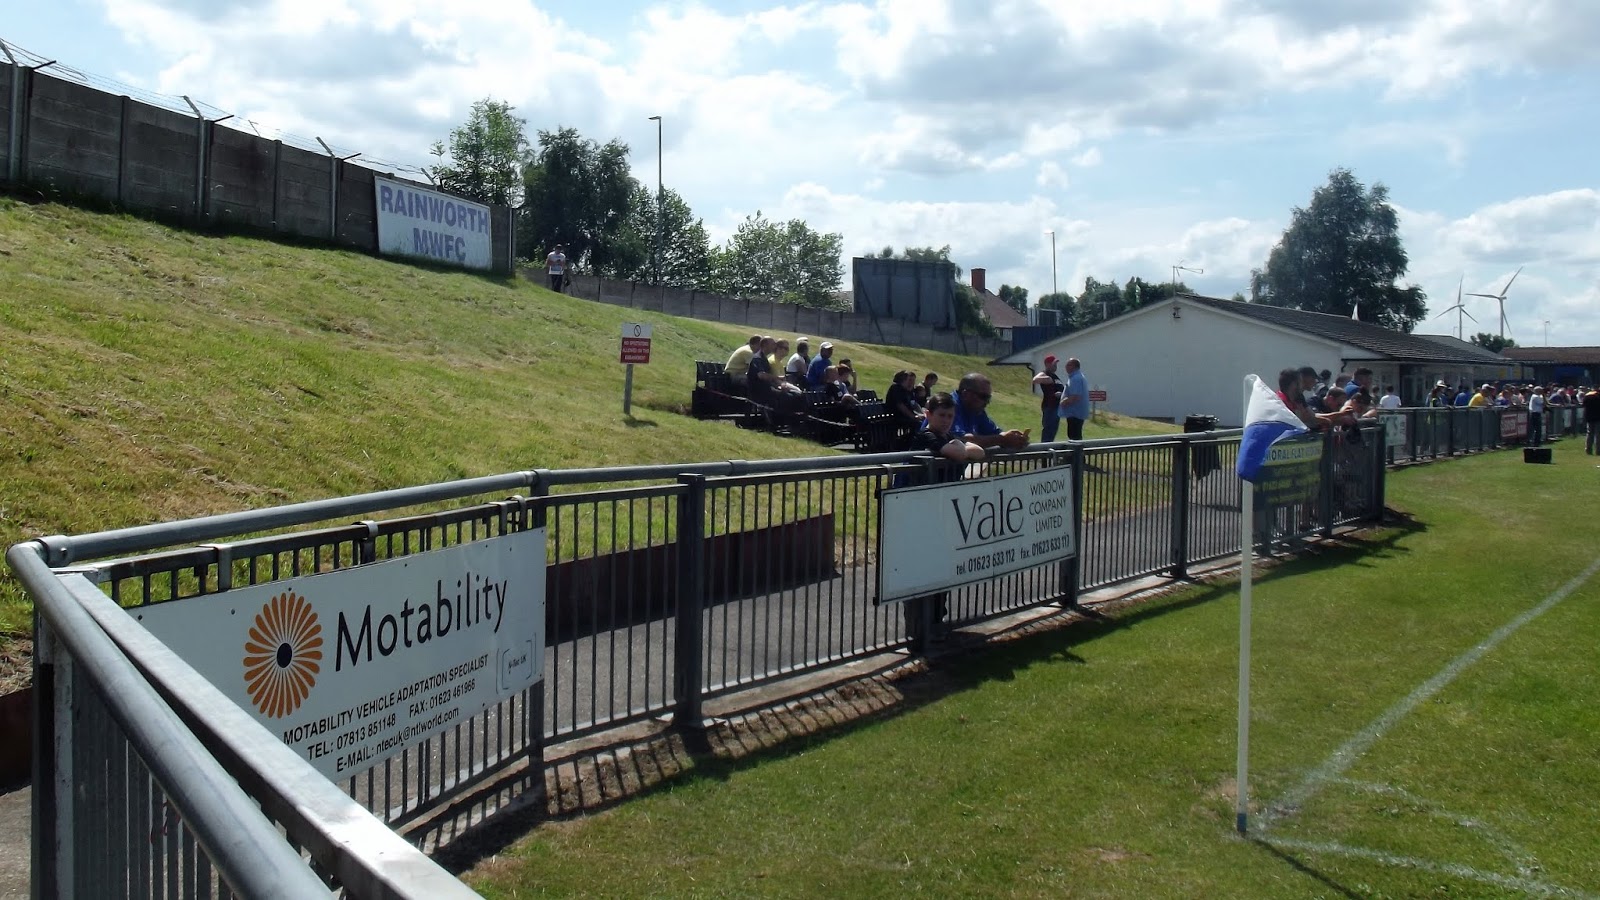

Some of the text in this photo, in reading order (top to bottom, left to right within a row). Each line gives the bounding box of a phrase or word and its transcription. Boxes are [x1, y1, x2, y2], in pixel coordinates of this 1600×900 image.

[380, 185, 489, 235] RAINWORTH
[413, 227, 466, 261] MWFC
[1029, 496, 1067, 515] COMPANY
[1030, 479, 1065, 496] WINDOW
[951, 489, 1024, 544] Vale
[1036, 515, 1063, 533] LIMITED
[968, 554, 991, 573] 01623
[992, 551, 1004, 567] 633
[1005, 548, 1015, 563] 112
[1031, 540, 1050, 557] 01623
[1050, 537, 1061, 552] 633
[335, 571, 508, 672] Motability
[283, 653, 489, 745] MOTABILITY VEHICLE ADAPTATION SPECIALIST
[307, 741, 334, 761] TEL:
[337, 727, 366, 750] 07813
[368, 712, 396, 738] 851148
[409, 699, 428, 718] FAX:
[429, 689, 451, 709] 01623
[336, 746, 375, 773] E-MAIL:
